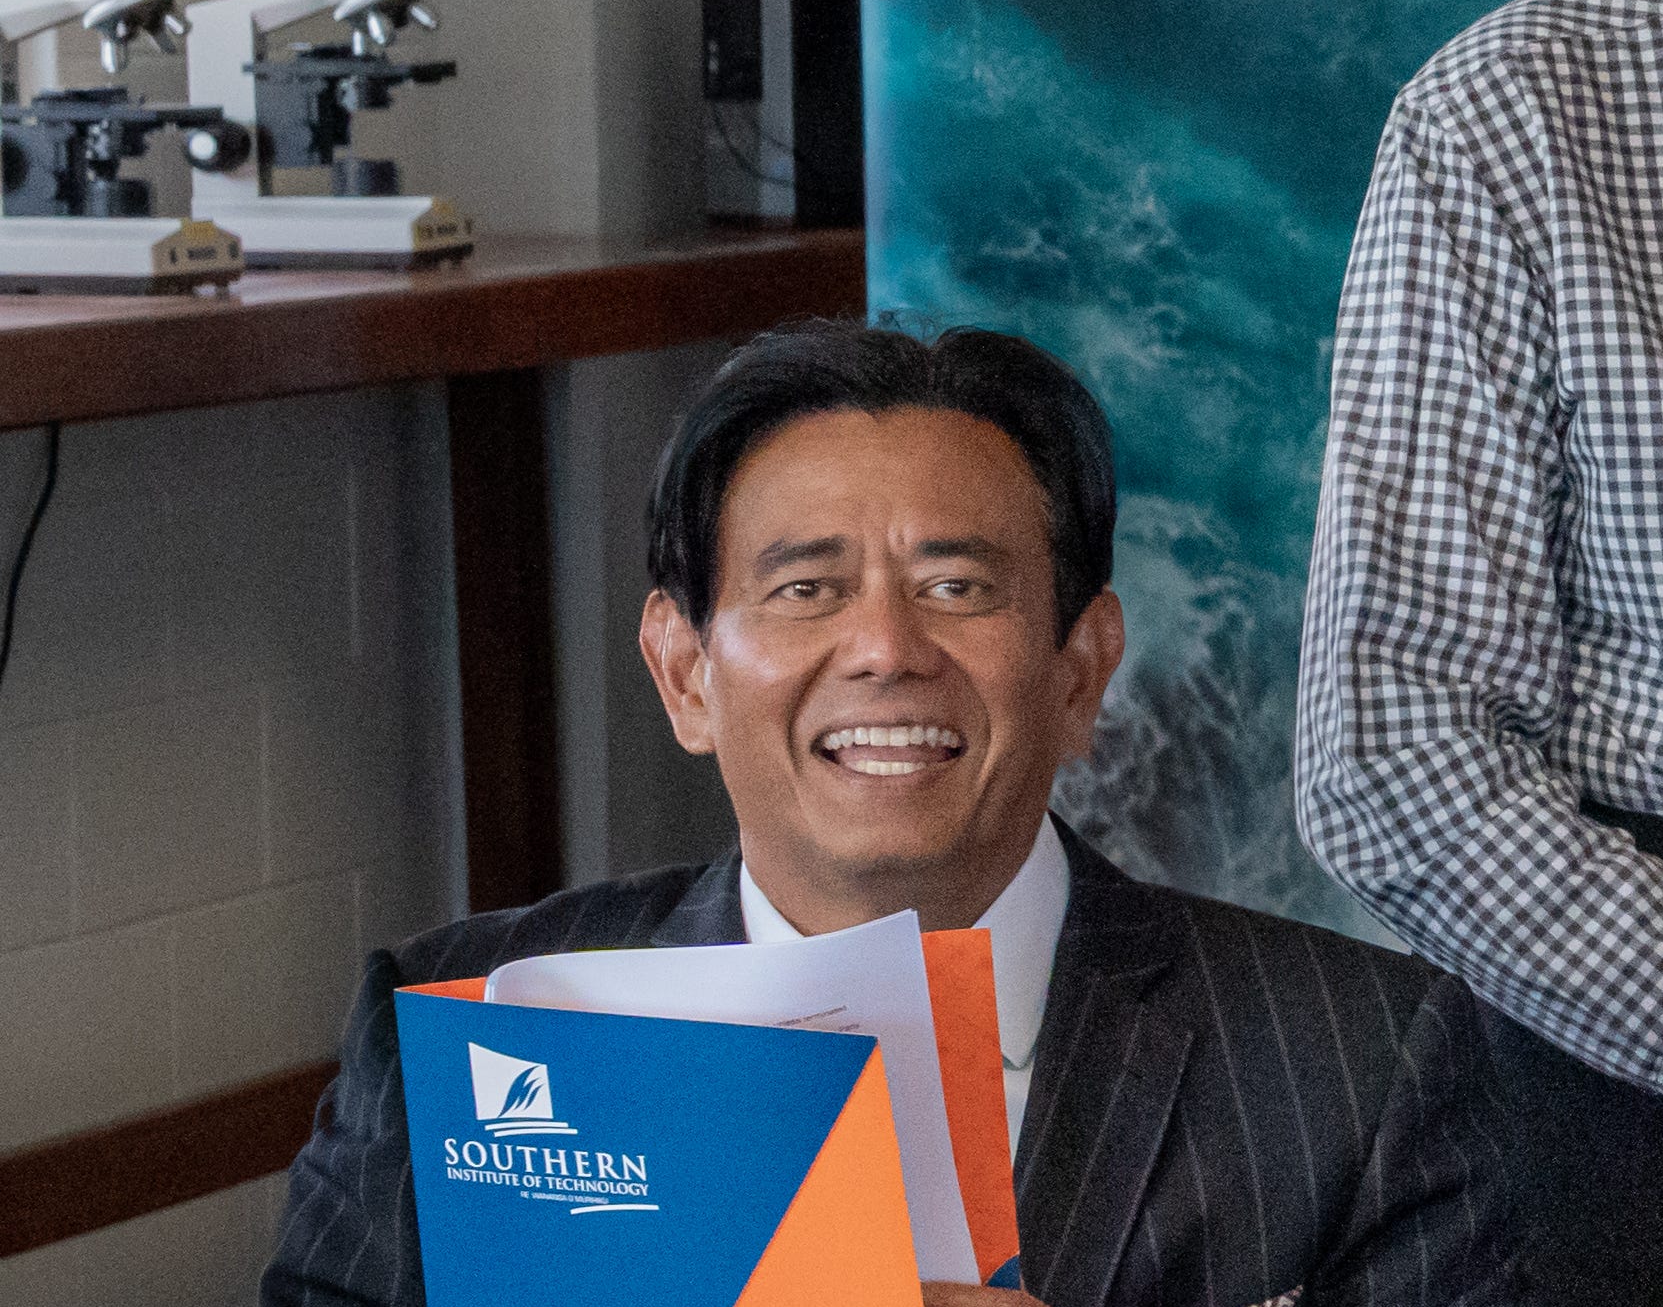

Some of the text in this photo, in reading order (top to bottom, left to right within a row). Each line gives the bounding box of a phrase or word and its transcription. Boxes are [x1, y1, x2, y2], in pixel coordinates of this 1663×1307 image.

[444, 1138, 648, 1181] SOUTHERN
[447, 1167, 649, 1196] INSTITUTE OF TECHNOLOGY
